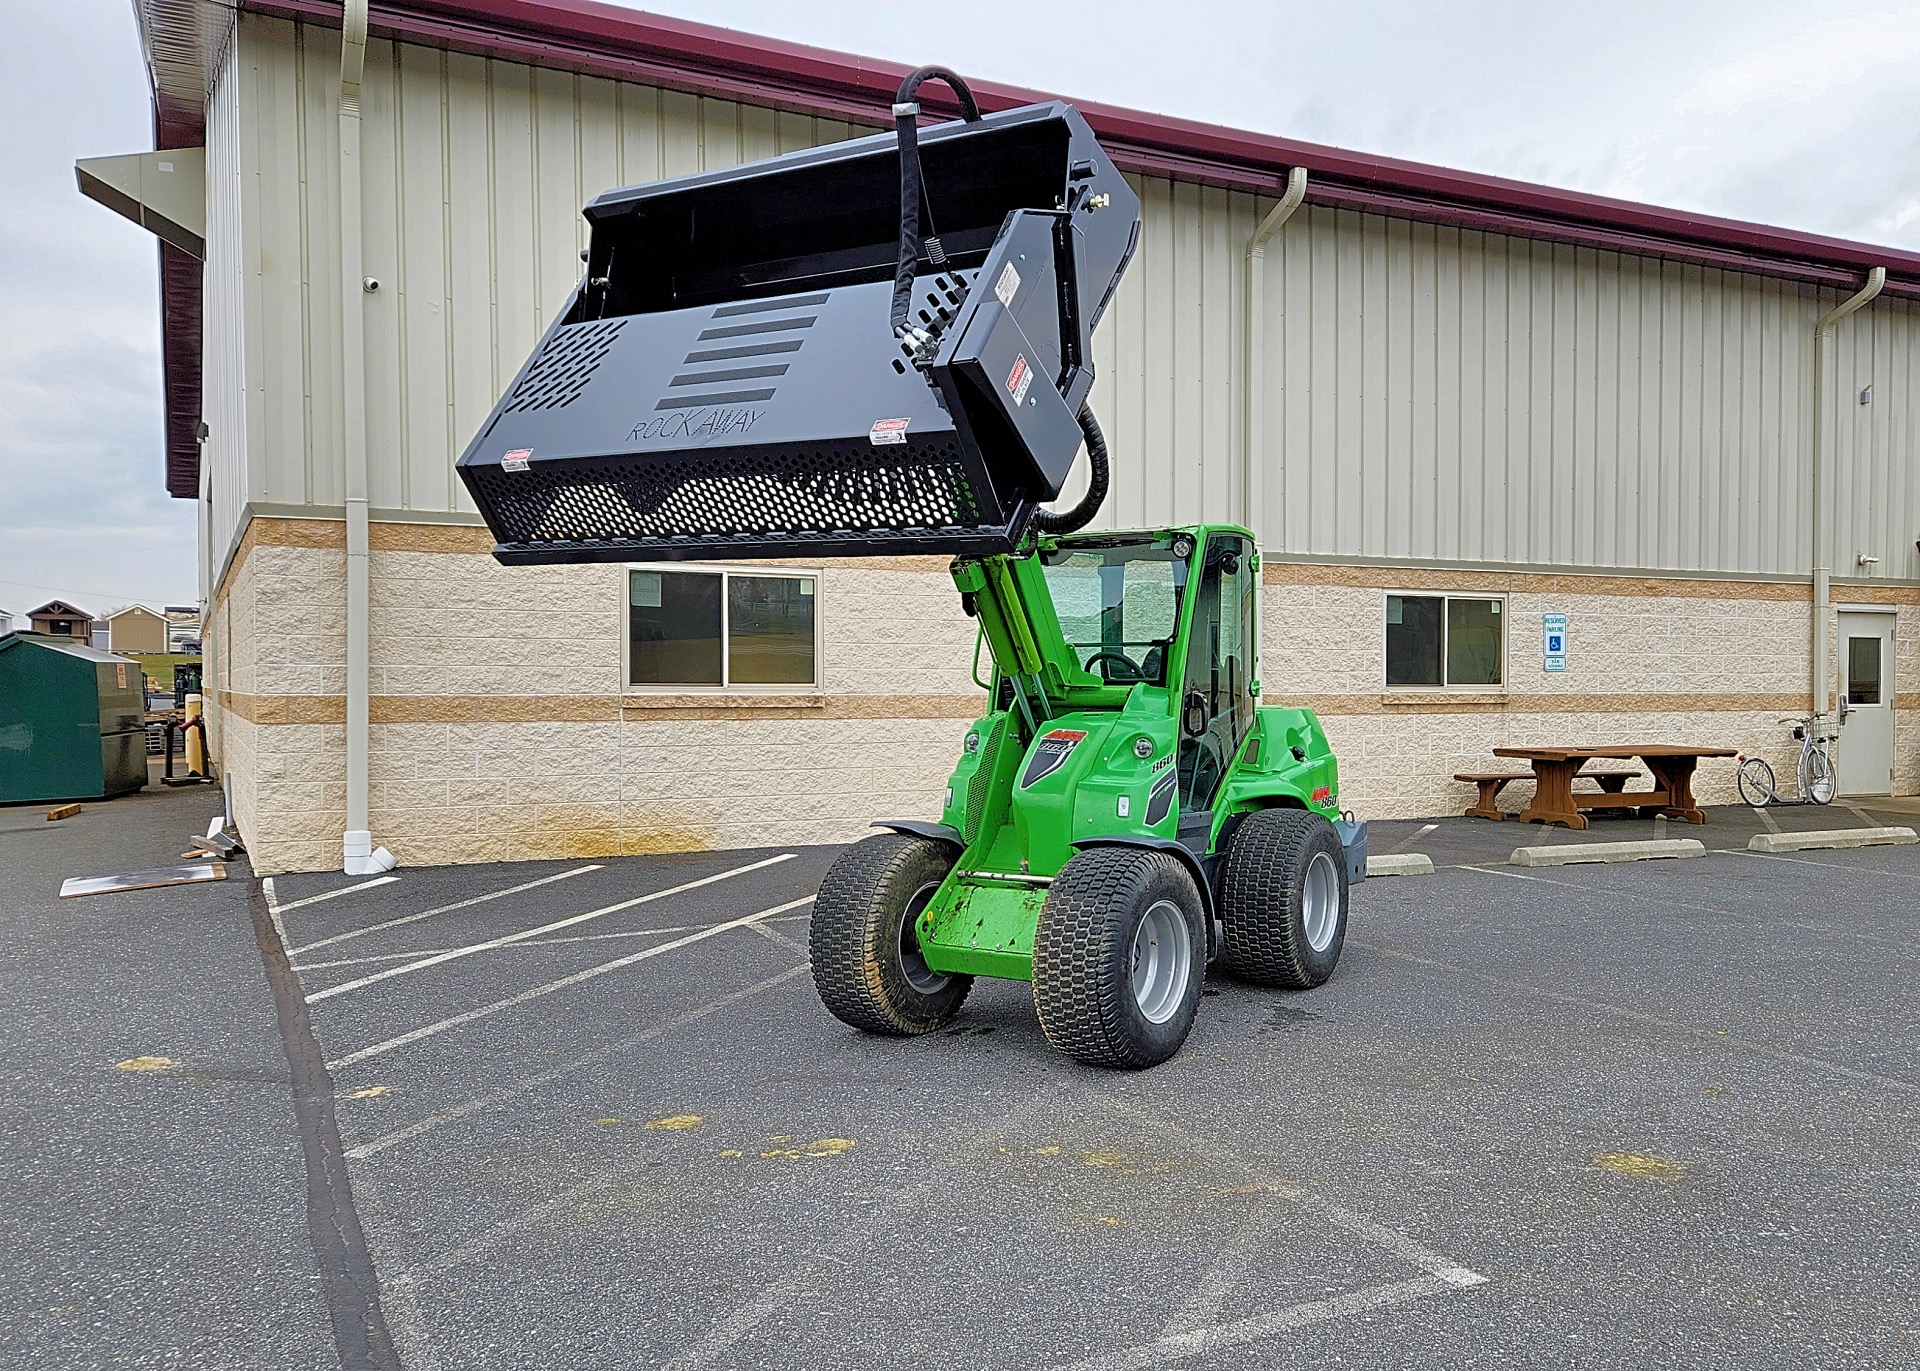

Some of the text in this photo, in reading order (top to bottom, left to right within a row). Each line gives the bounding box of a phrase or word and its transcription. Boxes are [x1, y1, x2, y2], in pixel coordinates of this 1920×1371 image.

[1009, 360, 1025, 390] DANGER
[625, 408, 766, 441] ROCKAWAY
[876, 420, 906, 430] DANGER
[1151, 753, 1173, 774] 860
[1321, 794, 1337, 809] 860
